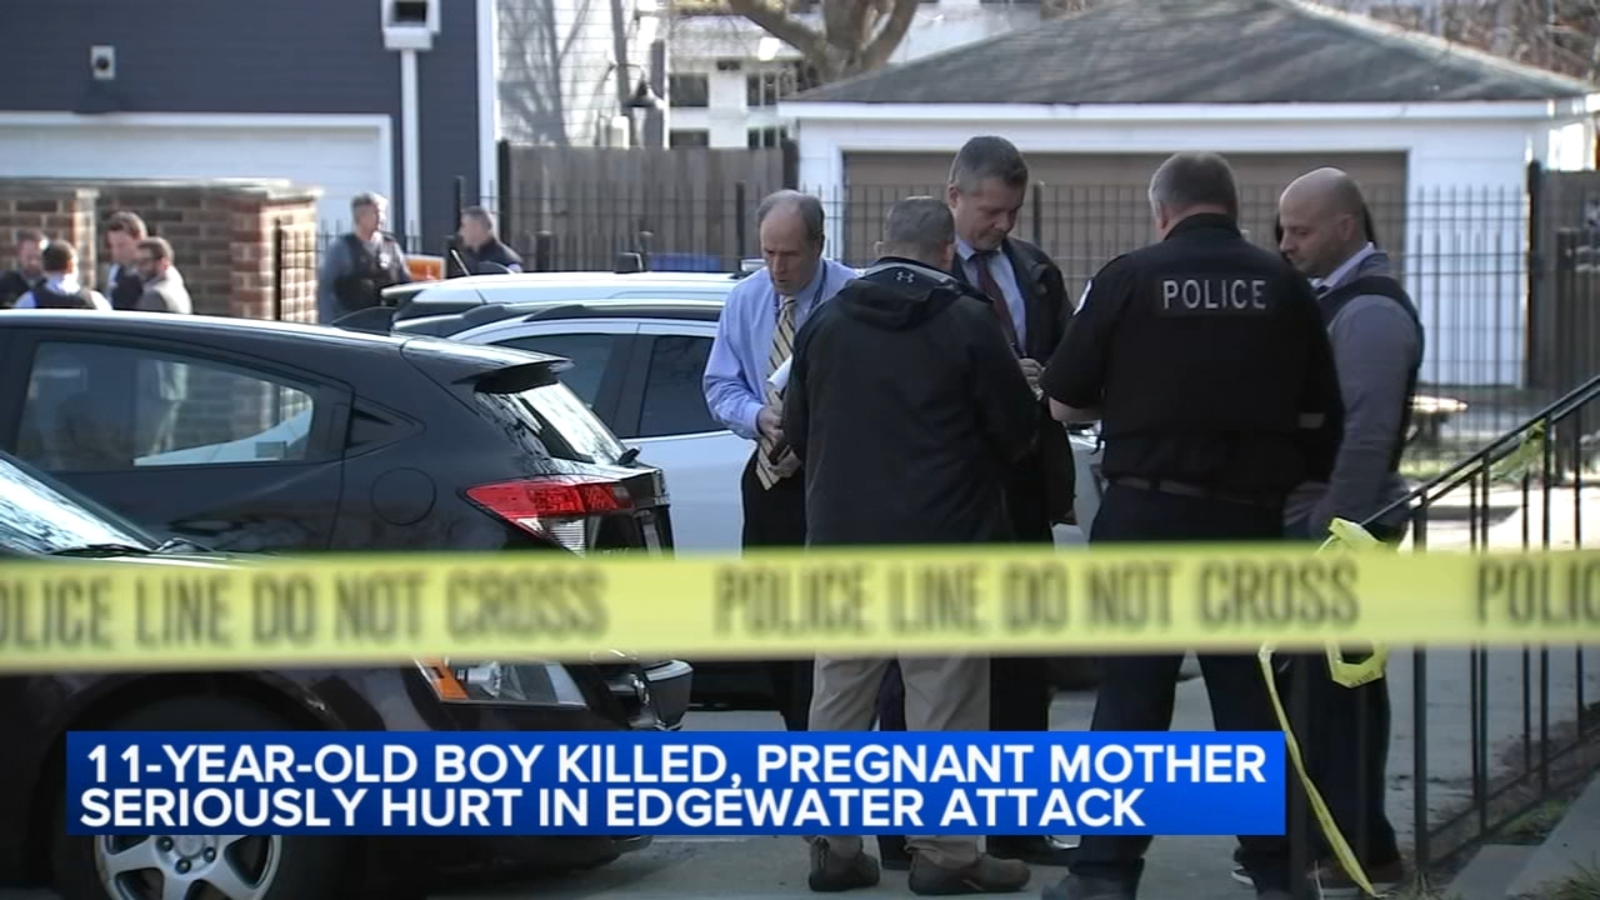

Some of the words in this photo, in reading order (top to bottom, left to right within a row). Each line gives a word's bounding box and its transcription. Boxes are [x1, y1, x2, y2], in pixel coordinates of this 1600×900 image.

[1163, 279, 1267, 309] POLICE
[134, 574, 231, 646] LINE
[253, 570, 314, 646] DO
[335, 568, 428, 644] NOT
[446, 567, 610, 643] CROSS
[714, 562, 875, 638] POLICE
[889, 561, 989, 636] LINE
[1003, 560, 1070, 634] DO
[1086, 558, 1178, 631] NOT
[1199, 557, 1360, 628] CROSS
